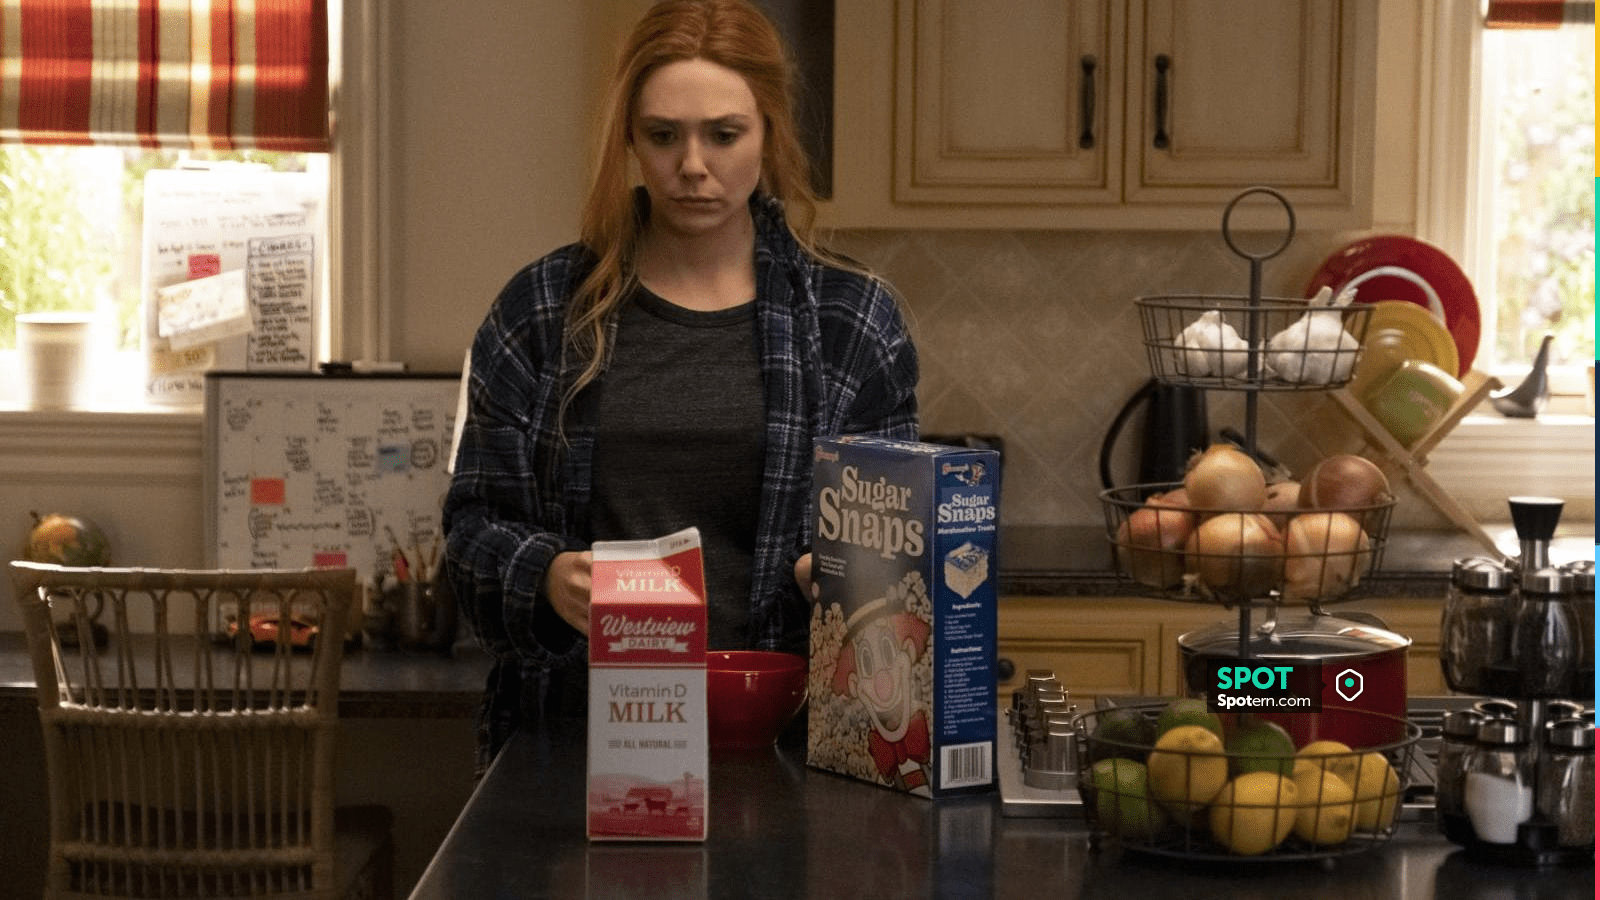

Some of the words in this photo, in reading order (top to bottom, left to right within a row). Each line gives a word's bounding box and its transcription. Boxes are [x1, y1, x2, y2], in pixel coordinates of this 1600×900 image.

[841, 466, 912, 513] Sugar
[951, 493, 990, 508] Sugar
[937, 502, 996, 523] Snaps
[819, 487, 925, 560] Snaps
[616, 578, 683, 593] MILK
[600, 614, 697, 637] Westview
[628, 638, 668, 649] DAIRY
[609, 684, 671, 698] Vitamin
[674, 684, 687, 698] D
[608, 702, 687, 723] MILK
[623, 740, 636, 749] ALL
[638, 740, 672, 749] NATURAL
